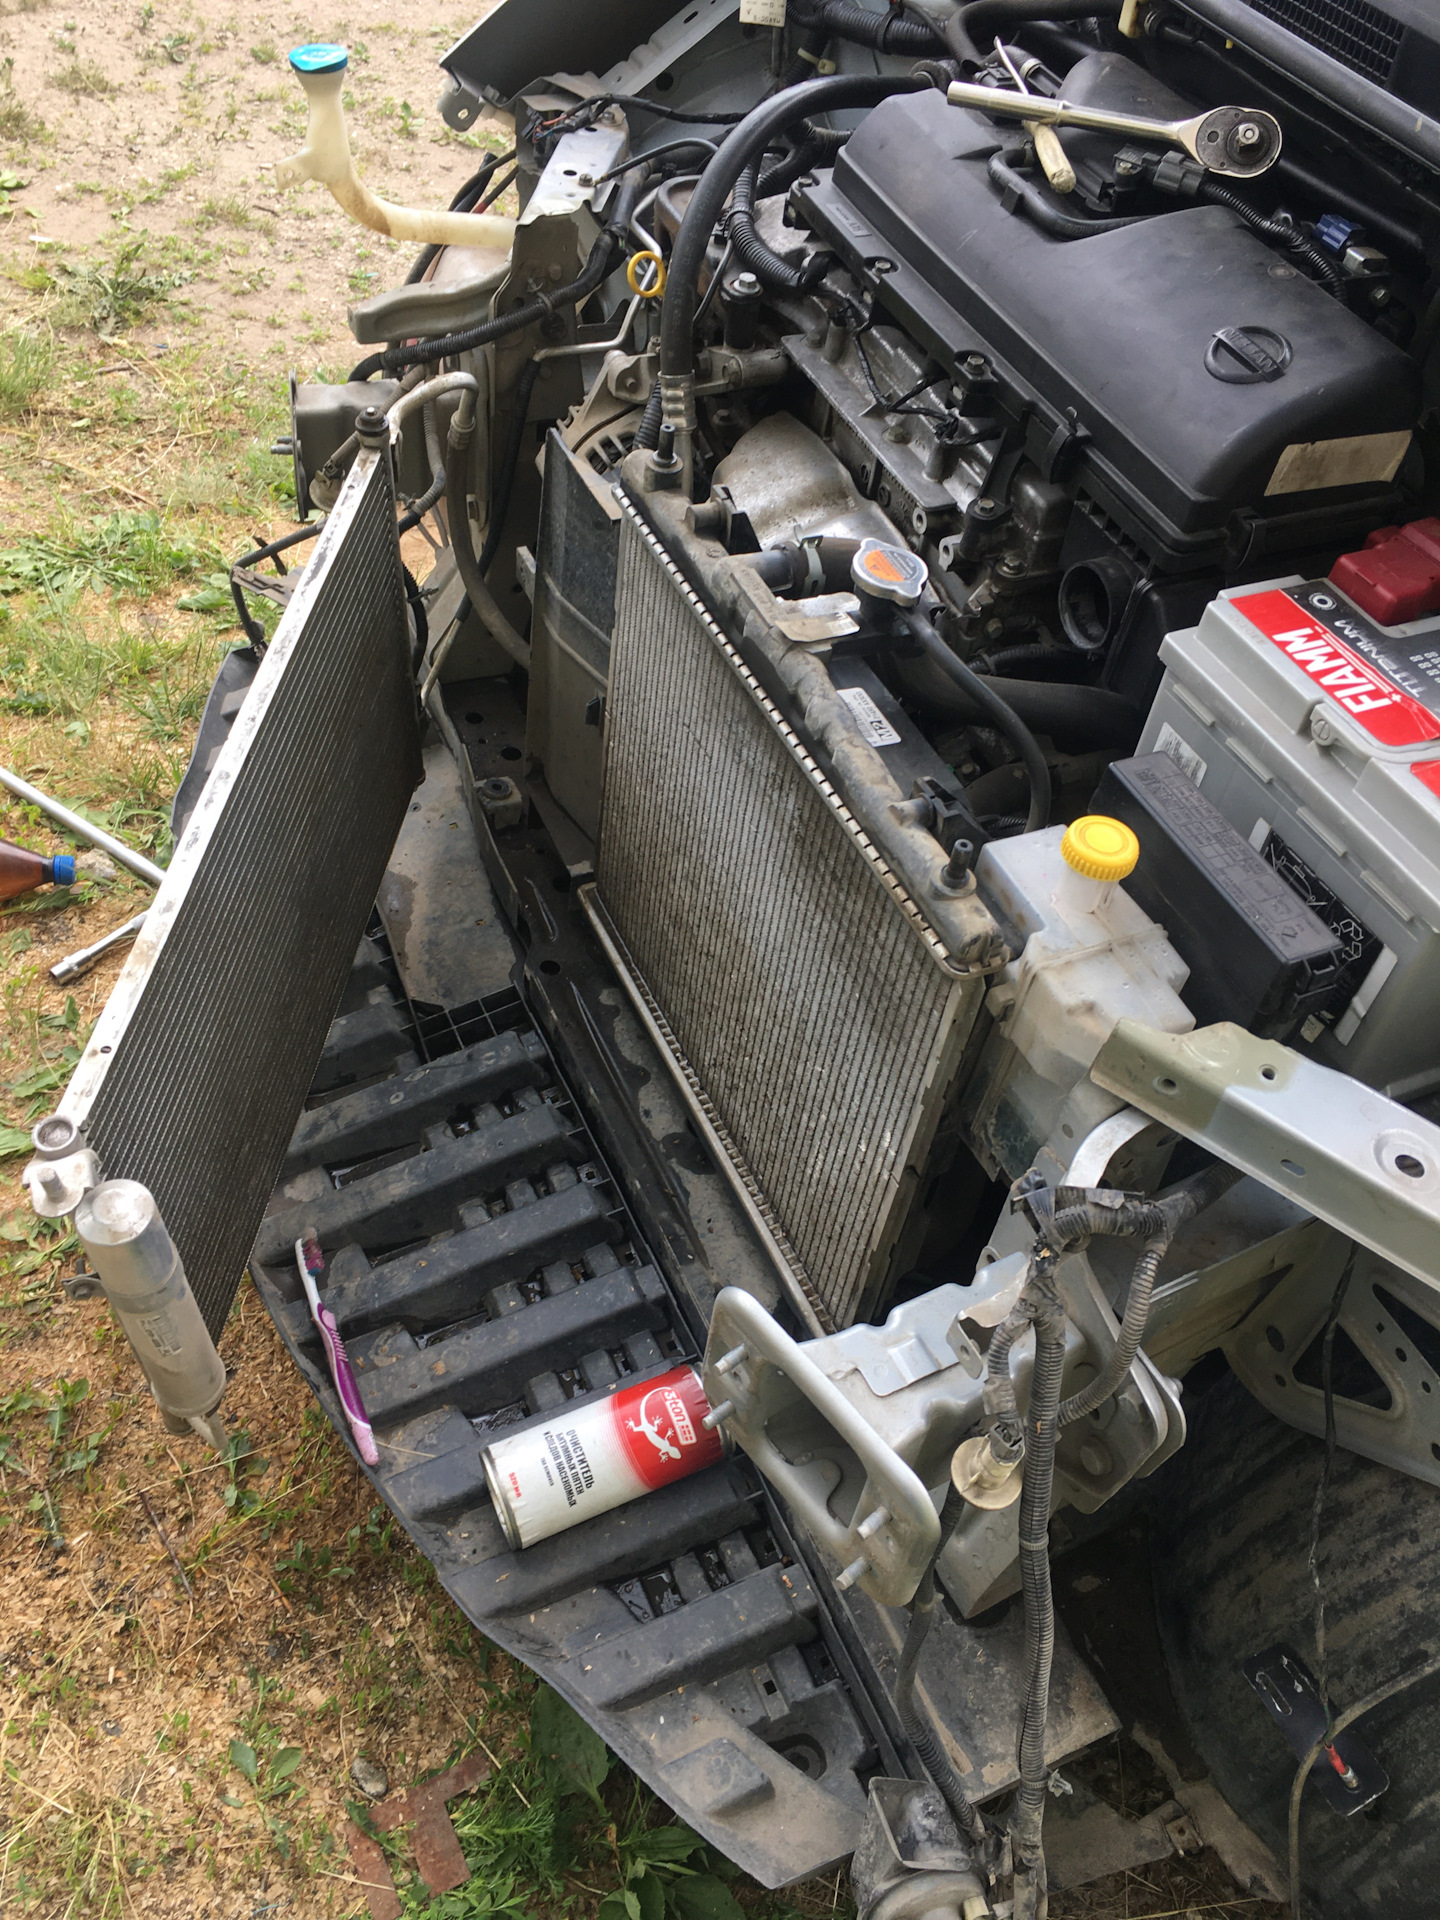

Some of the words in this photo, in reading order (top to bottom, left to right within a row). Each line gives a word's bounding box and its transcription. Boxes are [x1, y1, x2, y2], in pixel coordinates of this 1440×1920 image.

[1220, 328, 1279, 374] NISSAN
[1272, 627, 1393, 713] FIAMM
[870, 720, 894, 741] M2
[509, 1472, 518, 1486] 520
[545, 1434, 562, 1461] СЛЕДОВ
[555, 1460, 577, 1508] НАСЕКОМЫХ
[556, 1432, 577, 1471] БИТУМНЫХ
[570, 1471, 585, 1495] ПЯТЕН
[566, 1429, 595, 1489] ОЧИСТИТЕЛЬ
